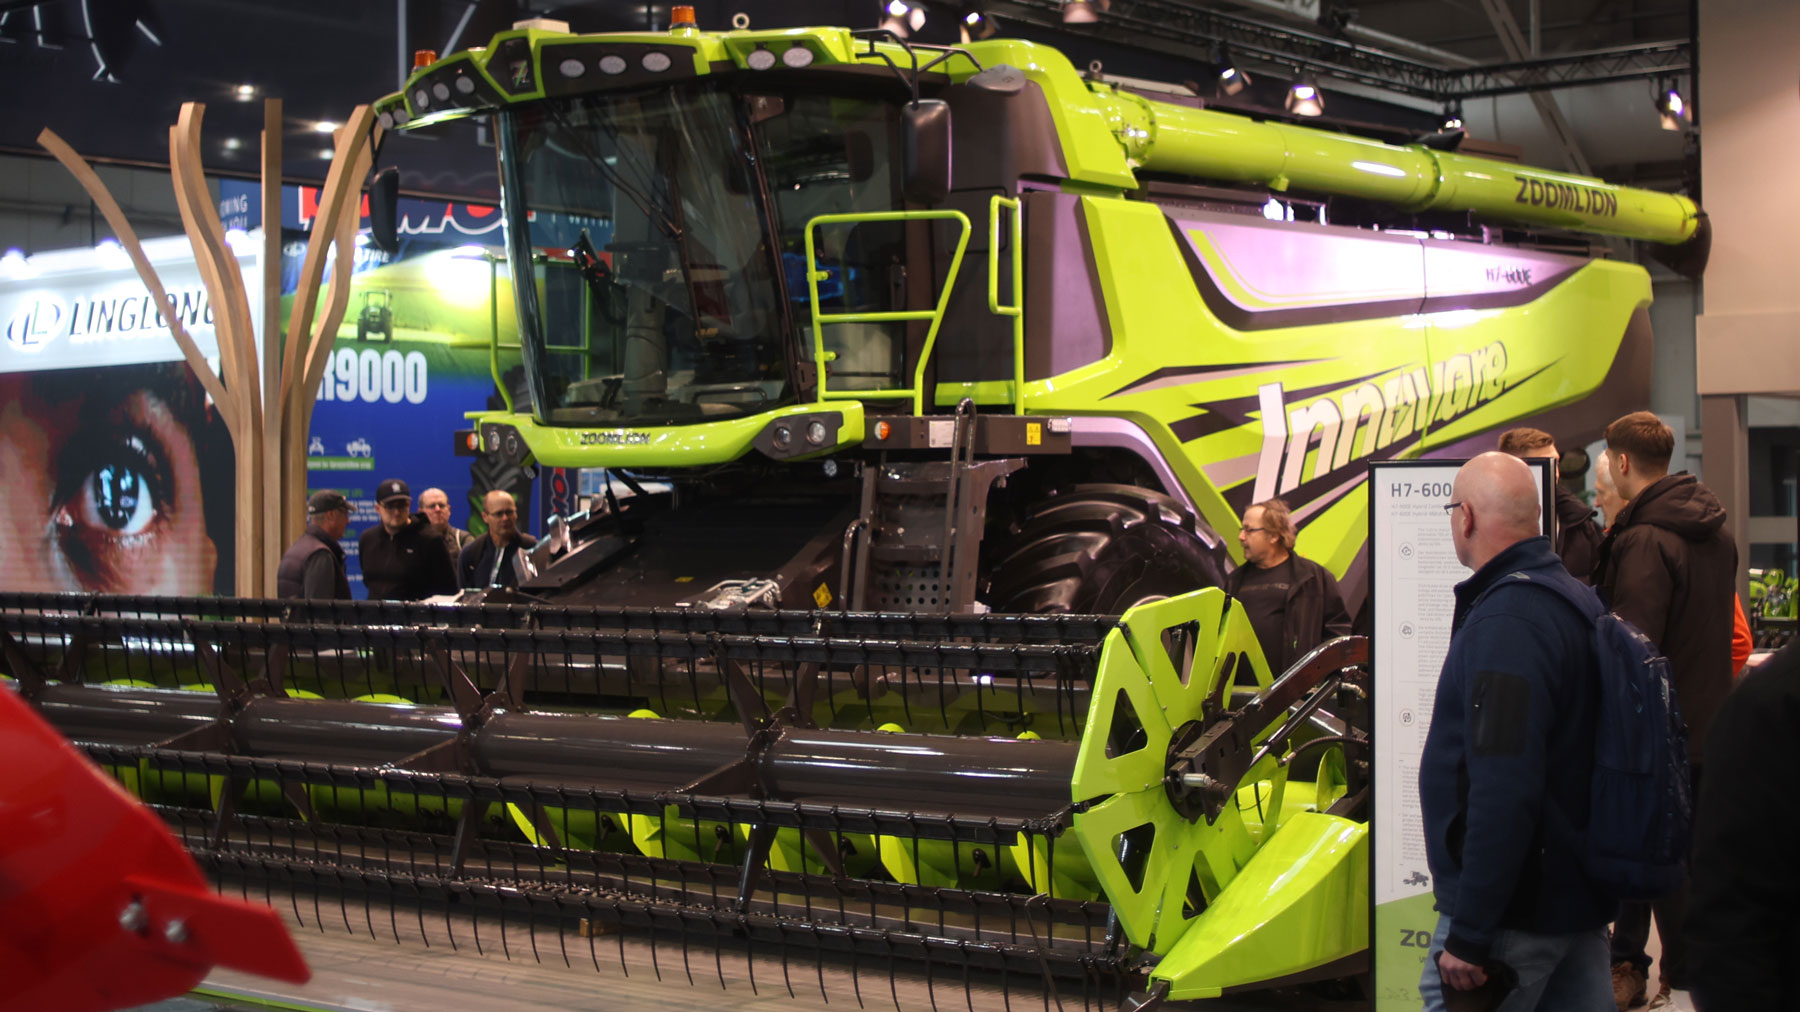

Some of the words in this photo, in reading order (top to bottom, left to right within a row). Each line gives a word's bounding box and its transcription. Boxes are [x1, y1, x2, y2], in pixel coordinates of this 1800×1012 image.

[1514, 176, 1618, 217] ZOOMLION
[69, 290, 215, 336] LINGLON
[580, 432, 651, 445] ZOOMLION
[1391, 482, 1452, 498] H7-600
